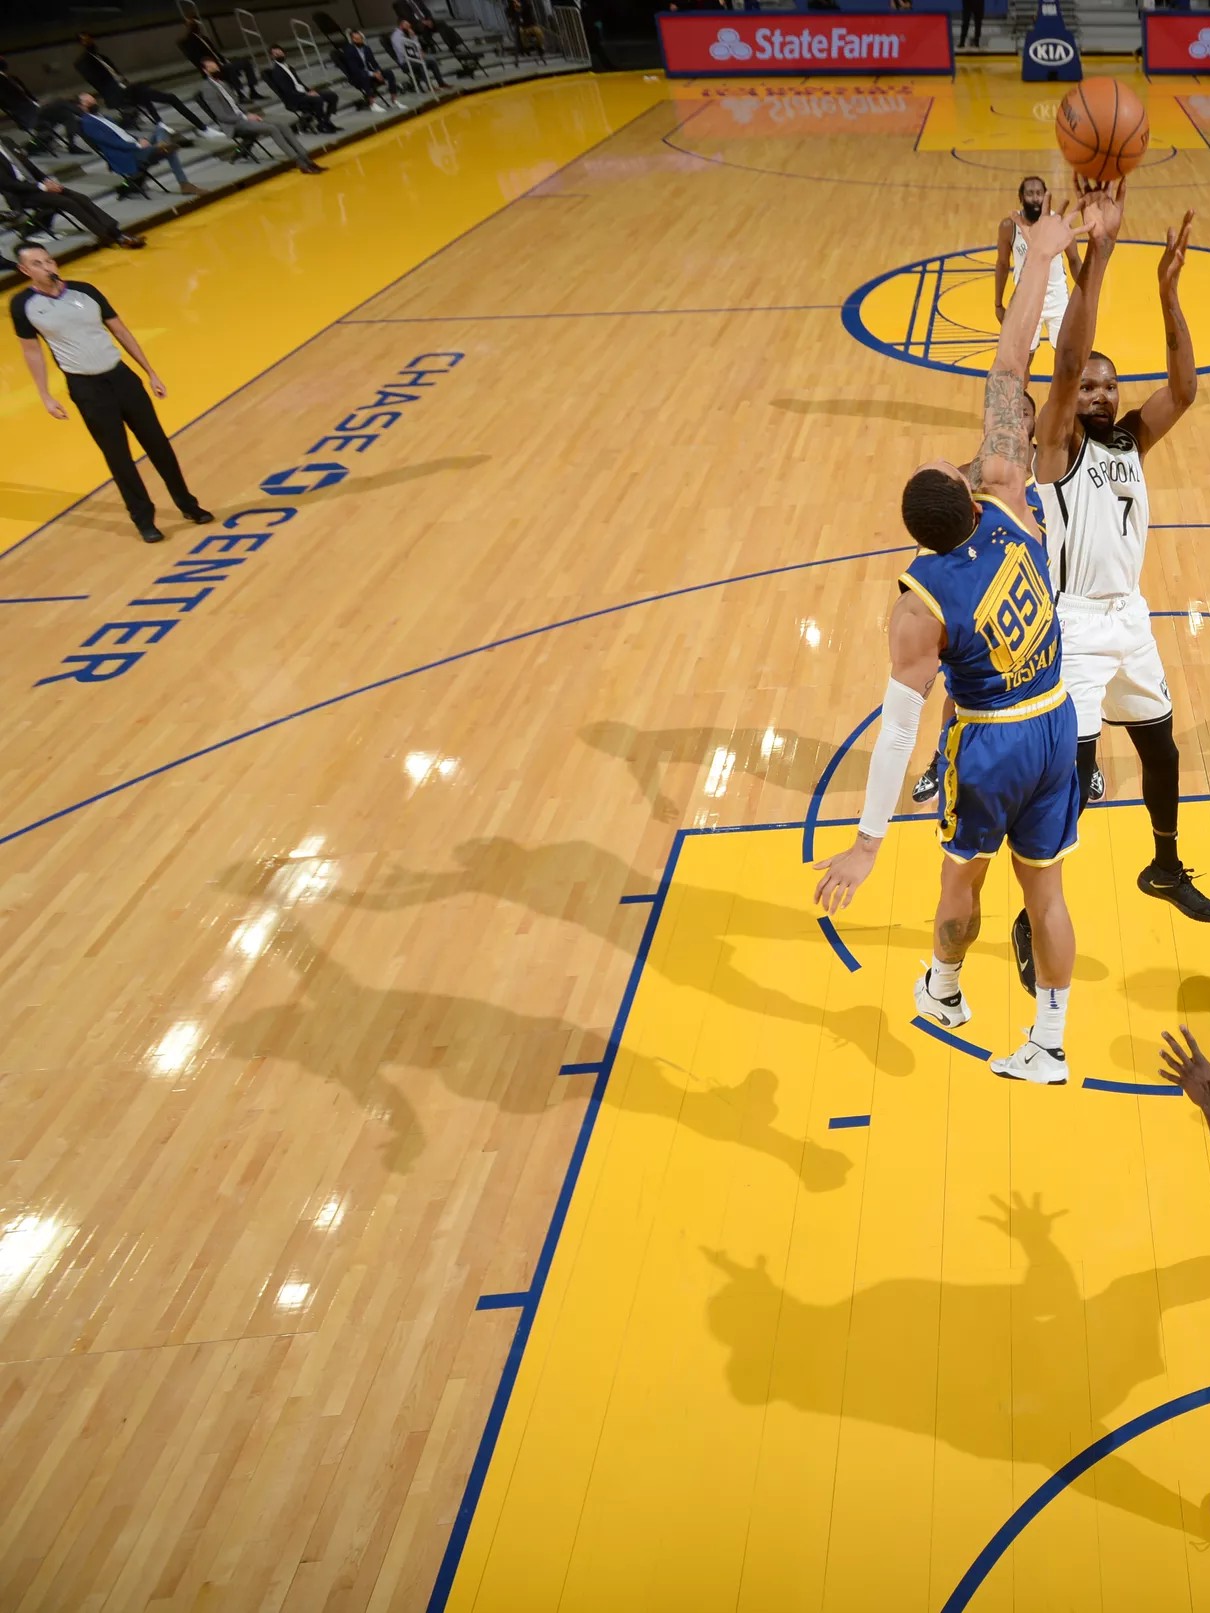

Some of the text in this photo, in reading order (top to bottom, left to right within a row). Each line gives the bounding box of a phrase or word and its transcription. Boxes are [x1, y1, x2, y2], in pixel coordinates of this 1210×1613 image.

[1036, 44, 1067, 60] KIA
[32, 352, 465, 688] CHASE CENTER
[1117, 496, 1134, 536] 7
[997, 571, 1039, 652] 95
